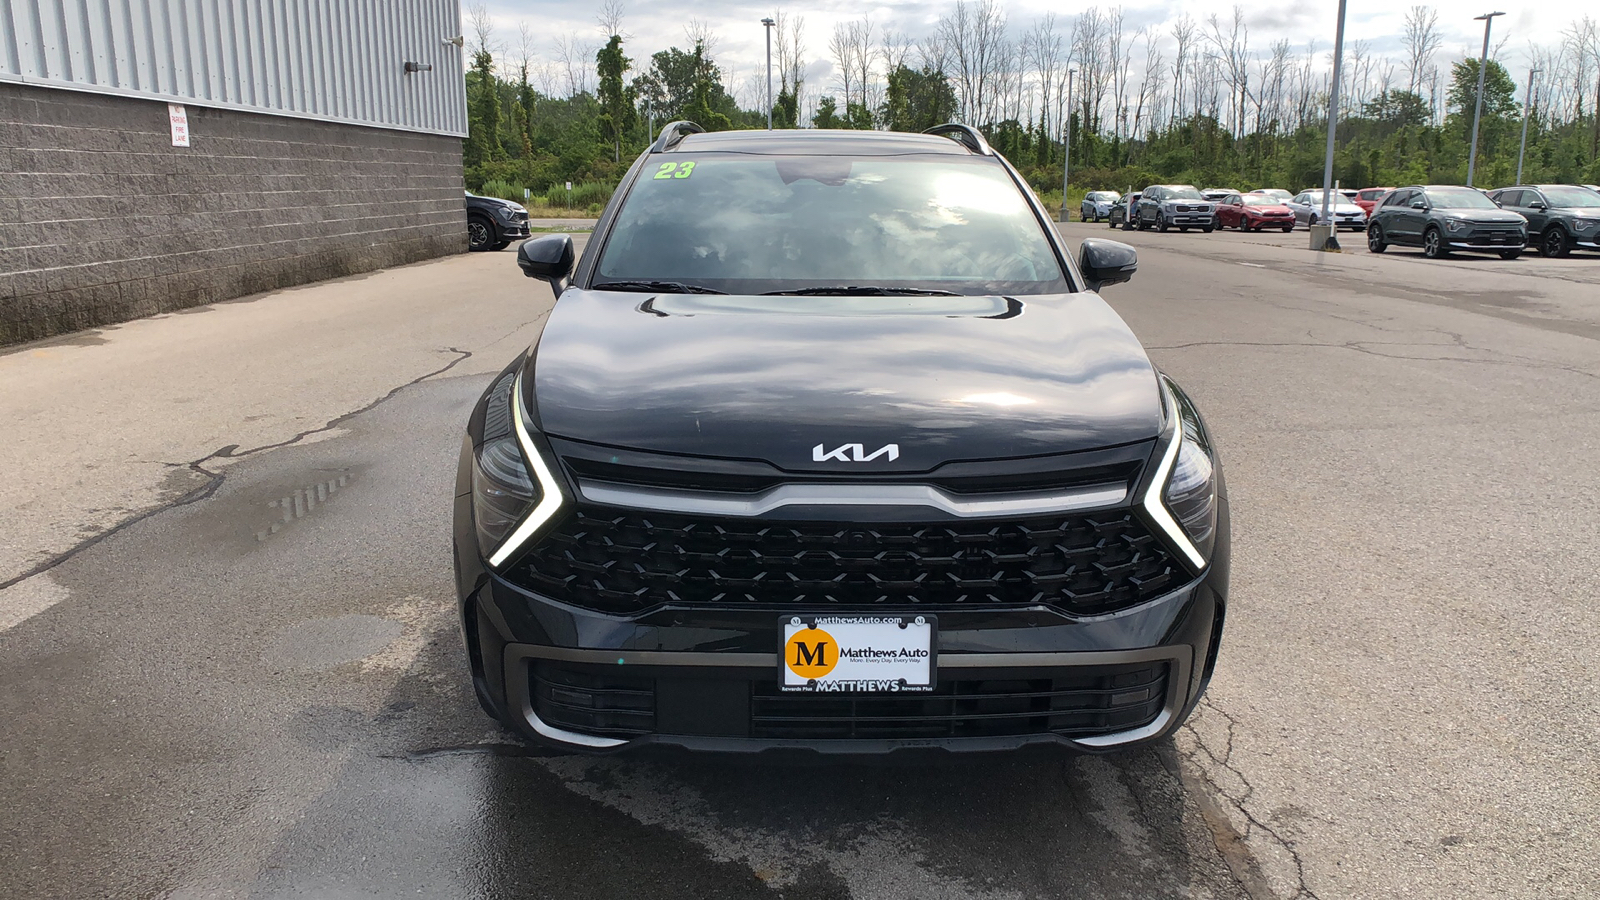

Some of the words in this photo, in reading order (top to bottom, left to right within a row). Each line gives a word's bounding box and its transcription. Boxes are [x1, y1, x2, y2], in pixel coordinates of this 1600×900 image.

[171, 116, 186, 124] PARKING
[653, 161, 696, 179] 23
[814, 616, 903, 624] MatthewsAuto.com
[792, 641, 828, 667] M
[839, 646, 897, 658] Matthews
[898, 647, 929, 658] Auto
[815, 680, 900, 692] MATTHEWS
